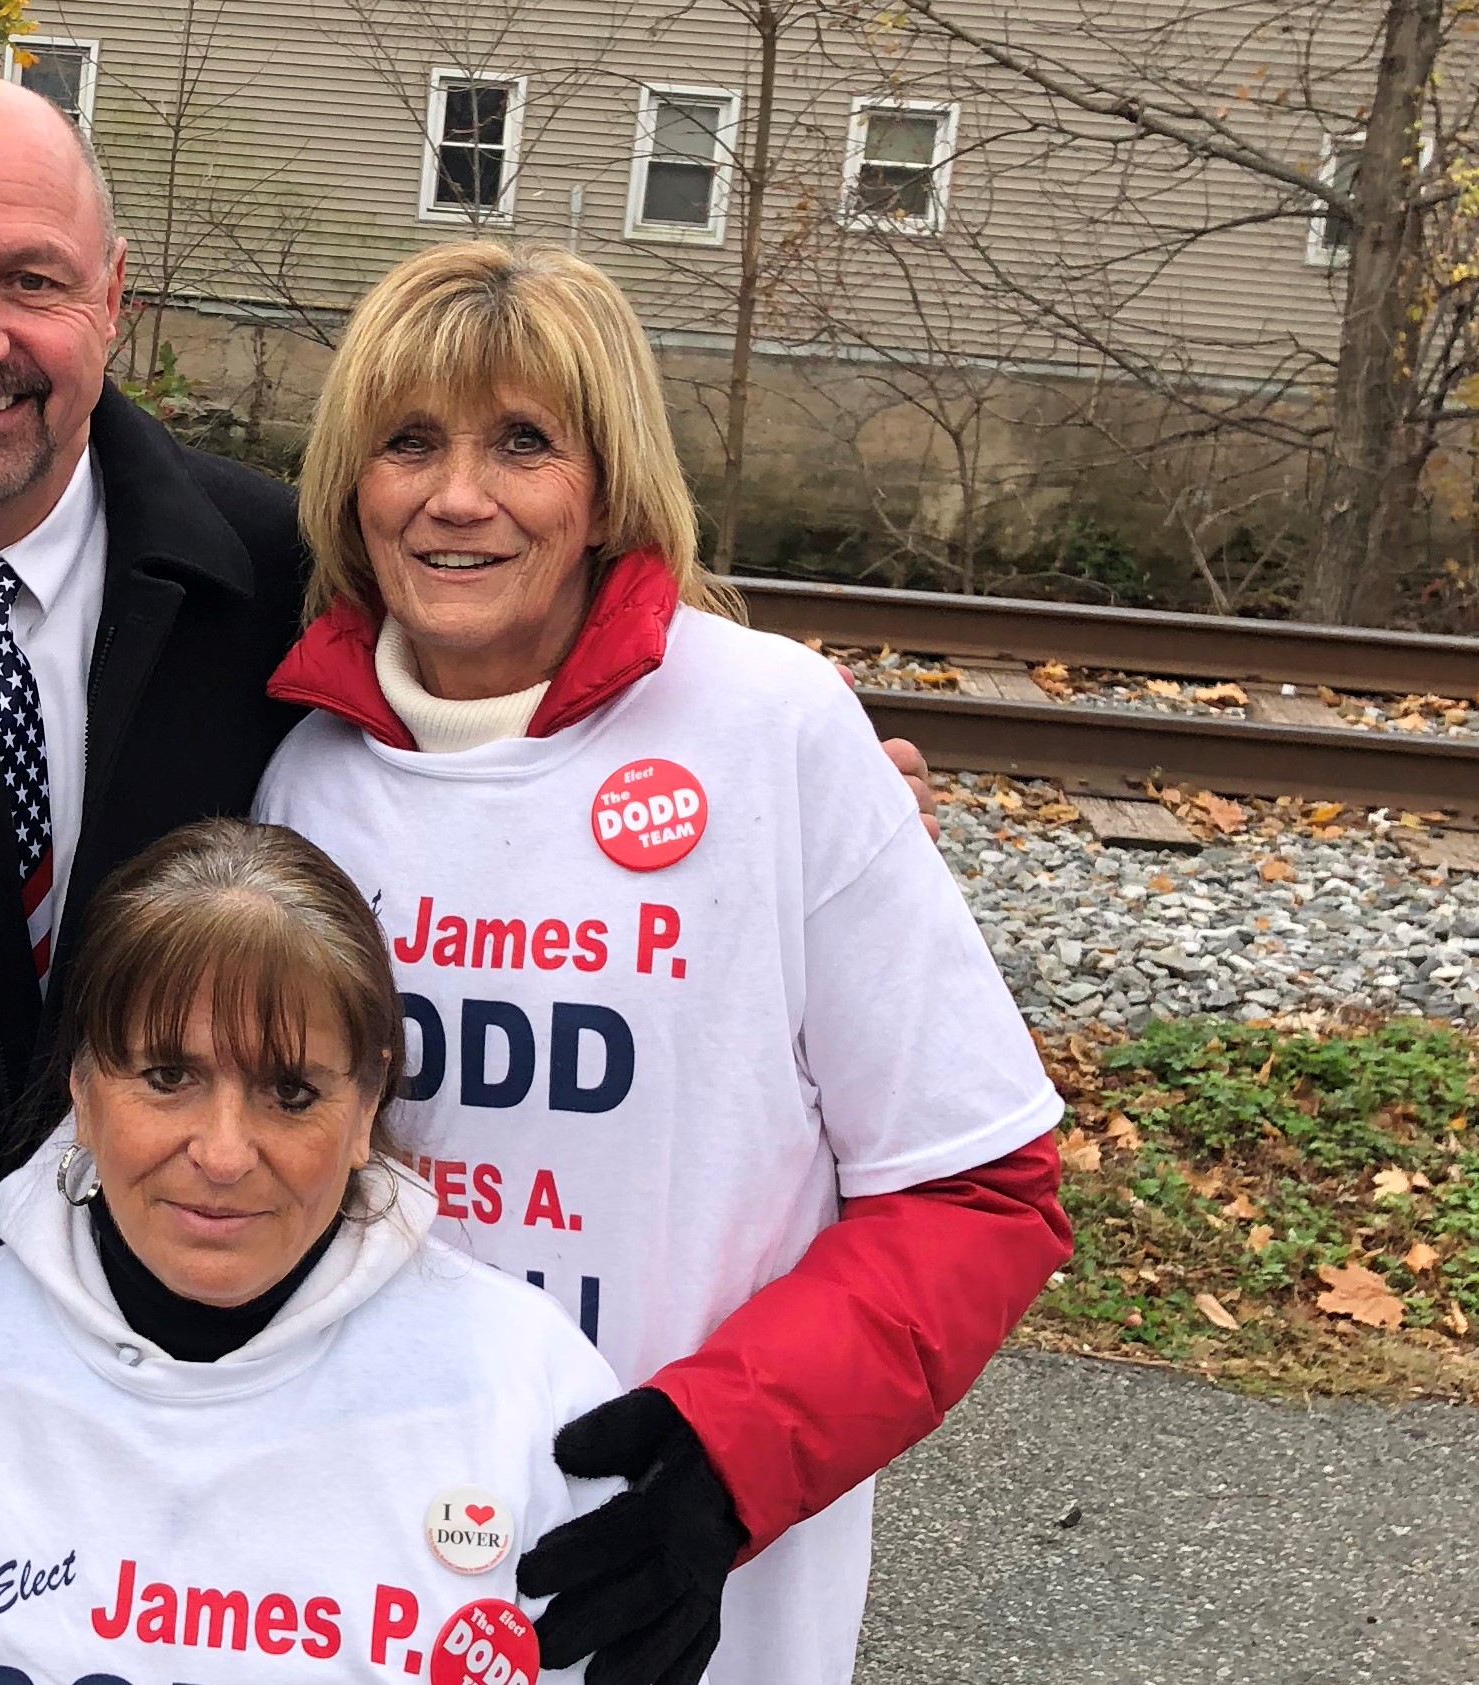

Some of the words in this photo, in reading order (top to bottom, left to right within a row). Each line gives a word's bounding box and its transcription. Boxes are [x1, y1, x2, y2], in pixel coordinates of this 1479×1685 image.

[624, 766, 654, 784] Elect
[601, 791, 631, 806] The
[597, 788, 700, 841] DODD
[638, 822, 696, 849] TEAM
[394, 896, 608, 972] James
[636, 902, 687, 979] P.
[396, 992, 635, 1114] ODD
[523, 1169, 582, 1232] A.
[442, 1504, 452, 1521] I
[437, 1529, 500, 1548] DOVER
[91, 1560, 342, 1659] James
[370, 1584, 423, 1675] P.
[471, 1607, 495, 1636] The
[499, 1610, 526, 1637] Elect
